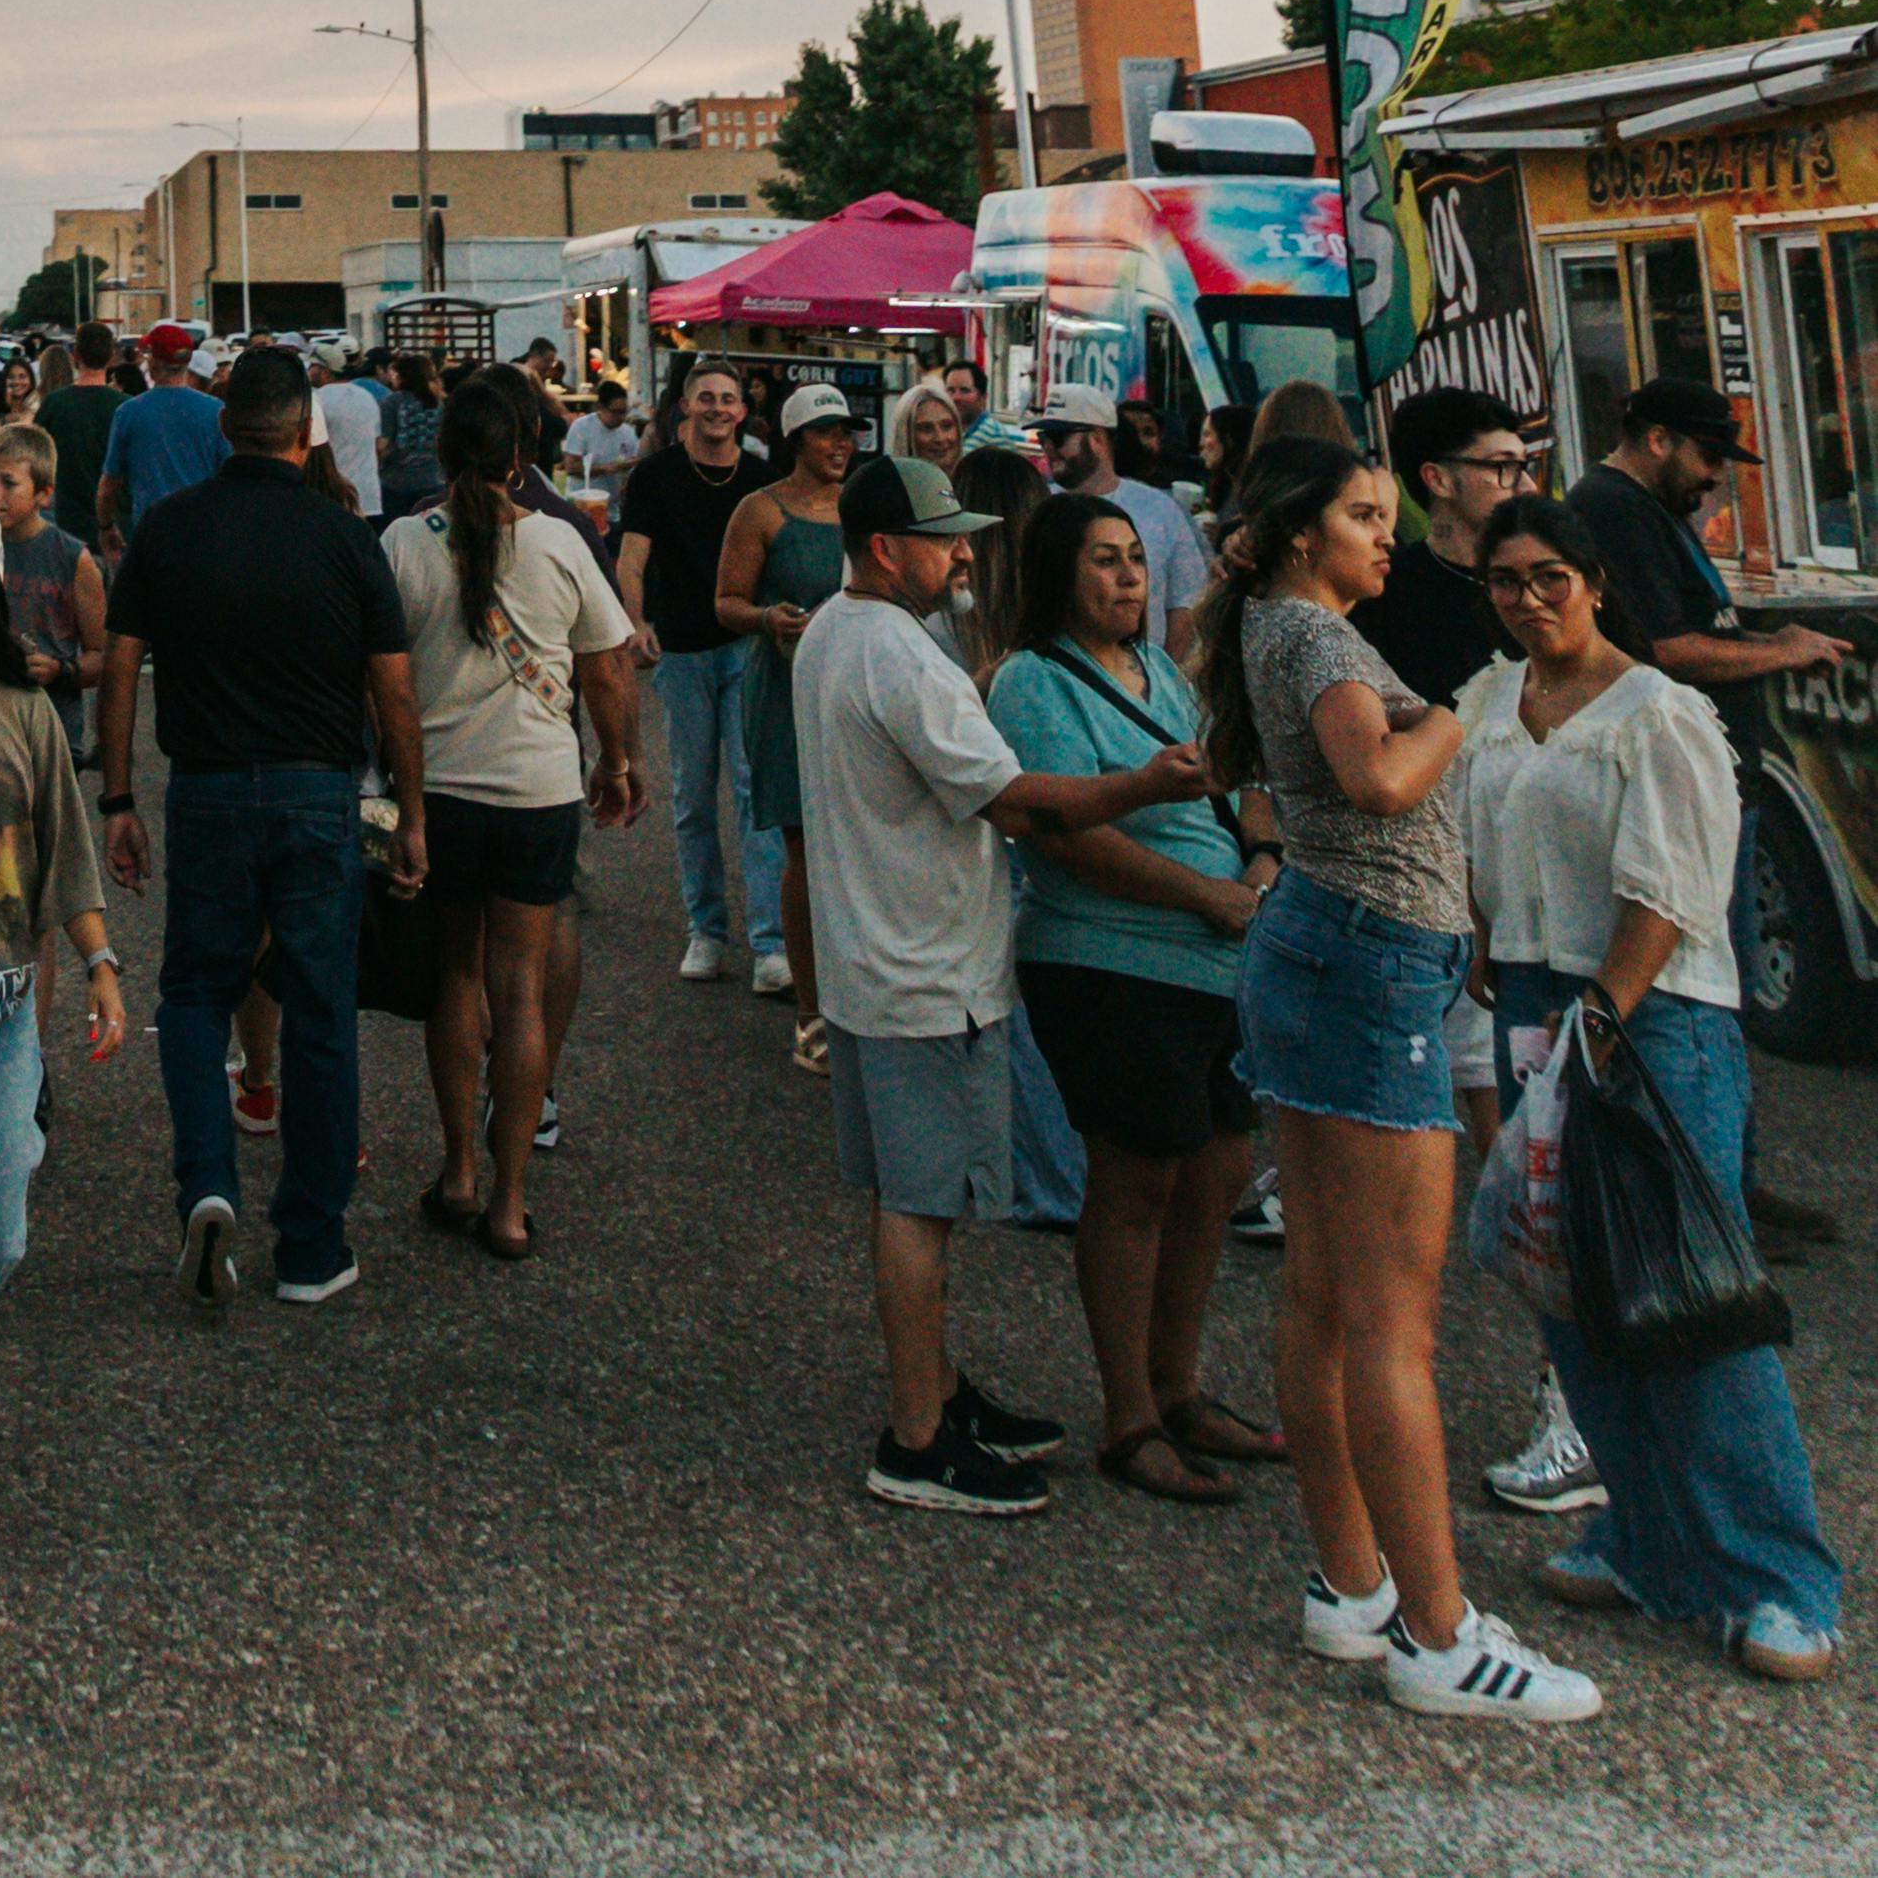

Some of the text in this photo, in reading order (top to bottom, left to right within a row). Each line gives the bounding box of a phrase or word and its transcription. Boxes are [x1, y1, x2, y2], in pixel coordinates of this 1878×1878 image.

[1586, 124, 1837, 207] 806.252.7773
[740, 295, 812, 312] Academy
[786, 364, 837, 383] CORN
[840, 368, 879, 386] GUY
